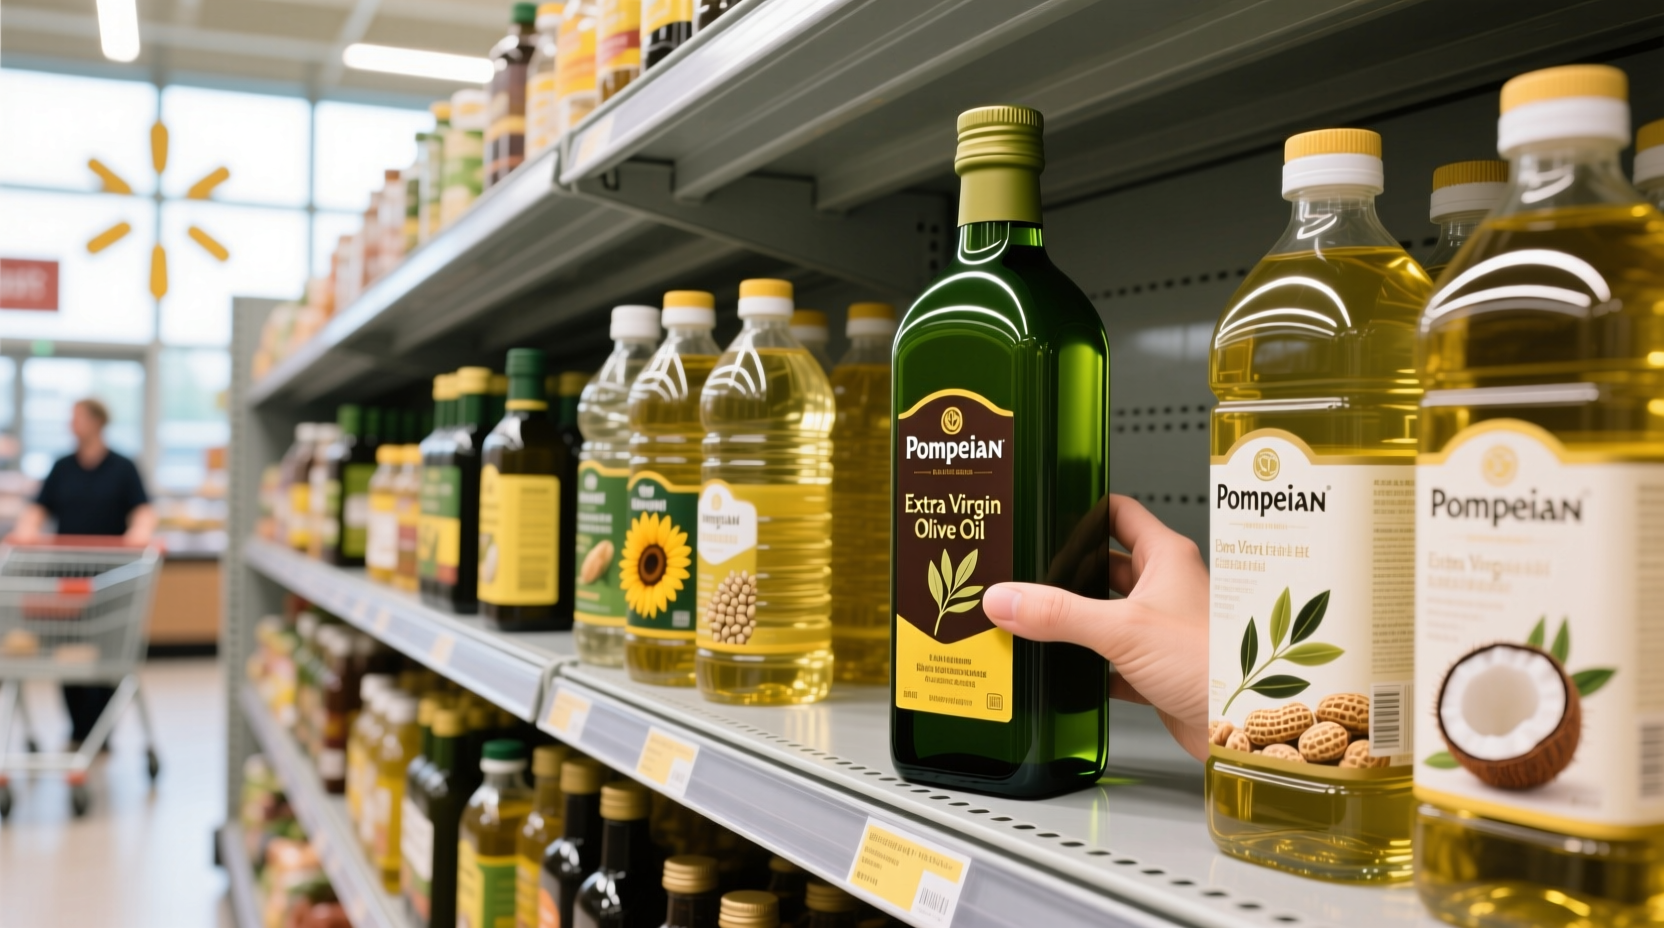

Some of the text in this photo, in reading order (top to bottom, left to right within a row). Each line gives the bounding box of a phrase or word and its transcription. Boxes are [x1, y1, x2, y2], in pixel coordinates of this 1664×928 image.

[905, 493, 1001, 520] Extra Virgin
[915, 518, 985, 540] Olive Oil
